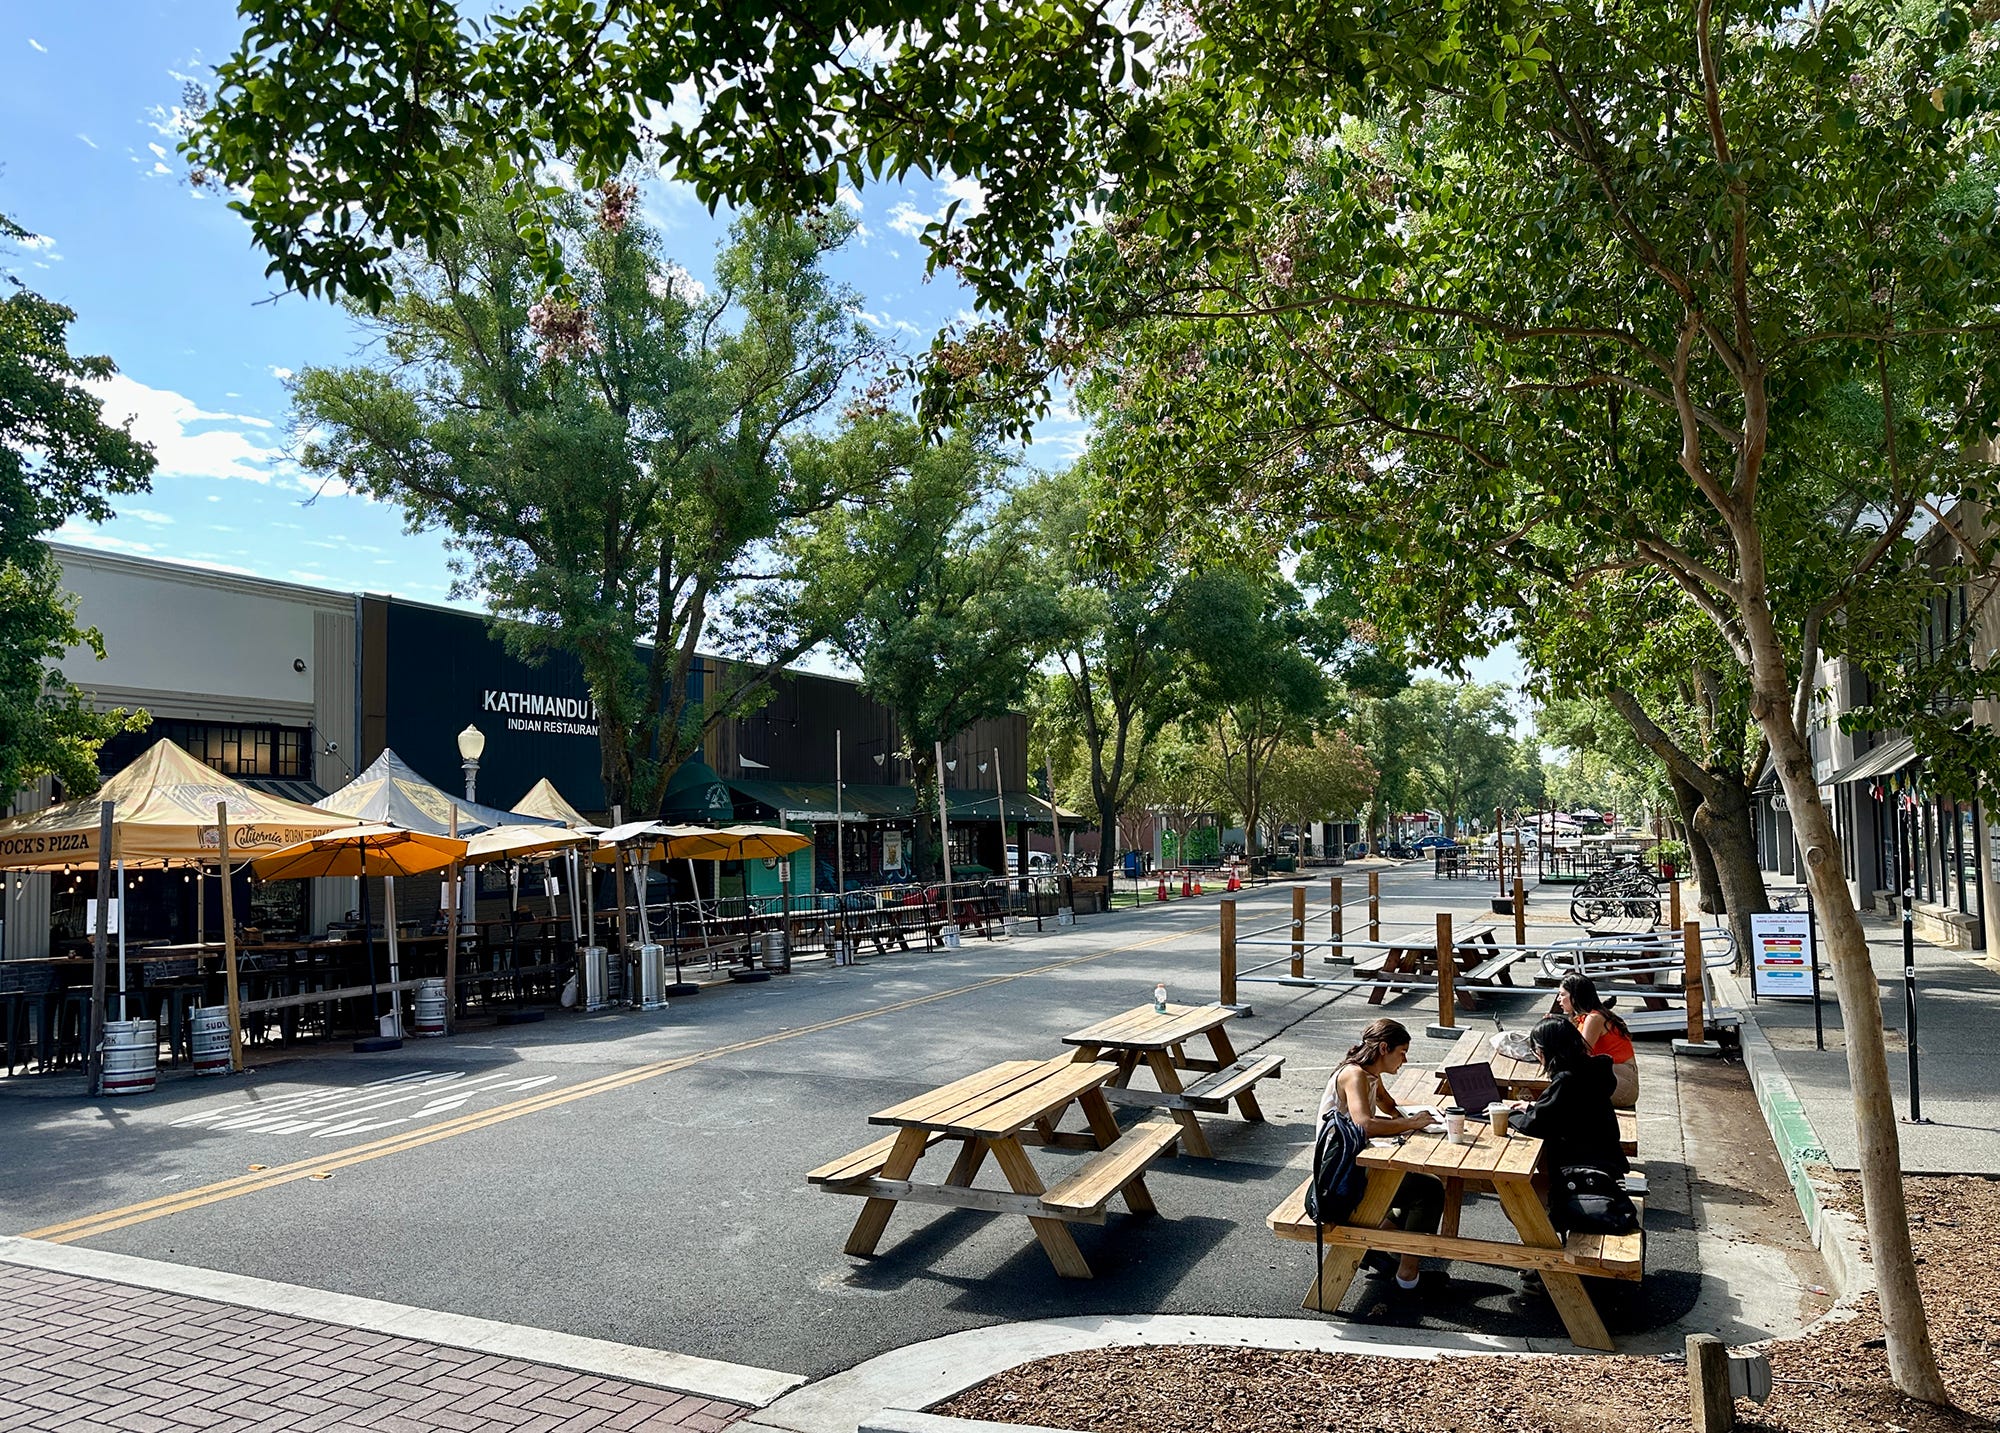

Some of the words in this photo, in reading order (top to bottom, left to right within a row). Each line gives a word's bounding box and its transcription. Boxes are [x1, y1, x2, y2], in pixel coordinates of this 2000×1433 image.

[484, 690, 588, 719] KATHMANDU
[508, 718, 542, 732] INDIAN
[544, 721, 601, 736] RESTAURAN
[48, 833, 90, 852] PIZZA
[234, 825, 283, 849] California
[284, 829, 304, 843] BORN
